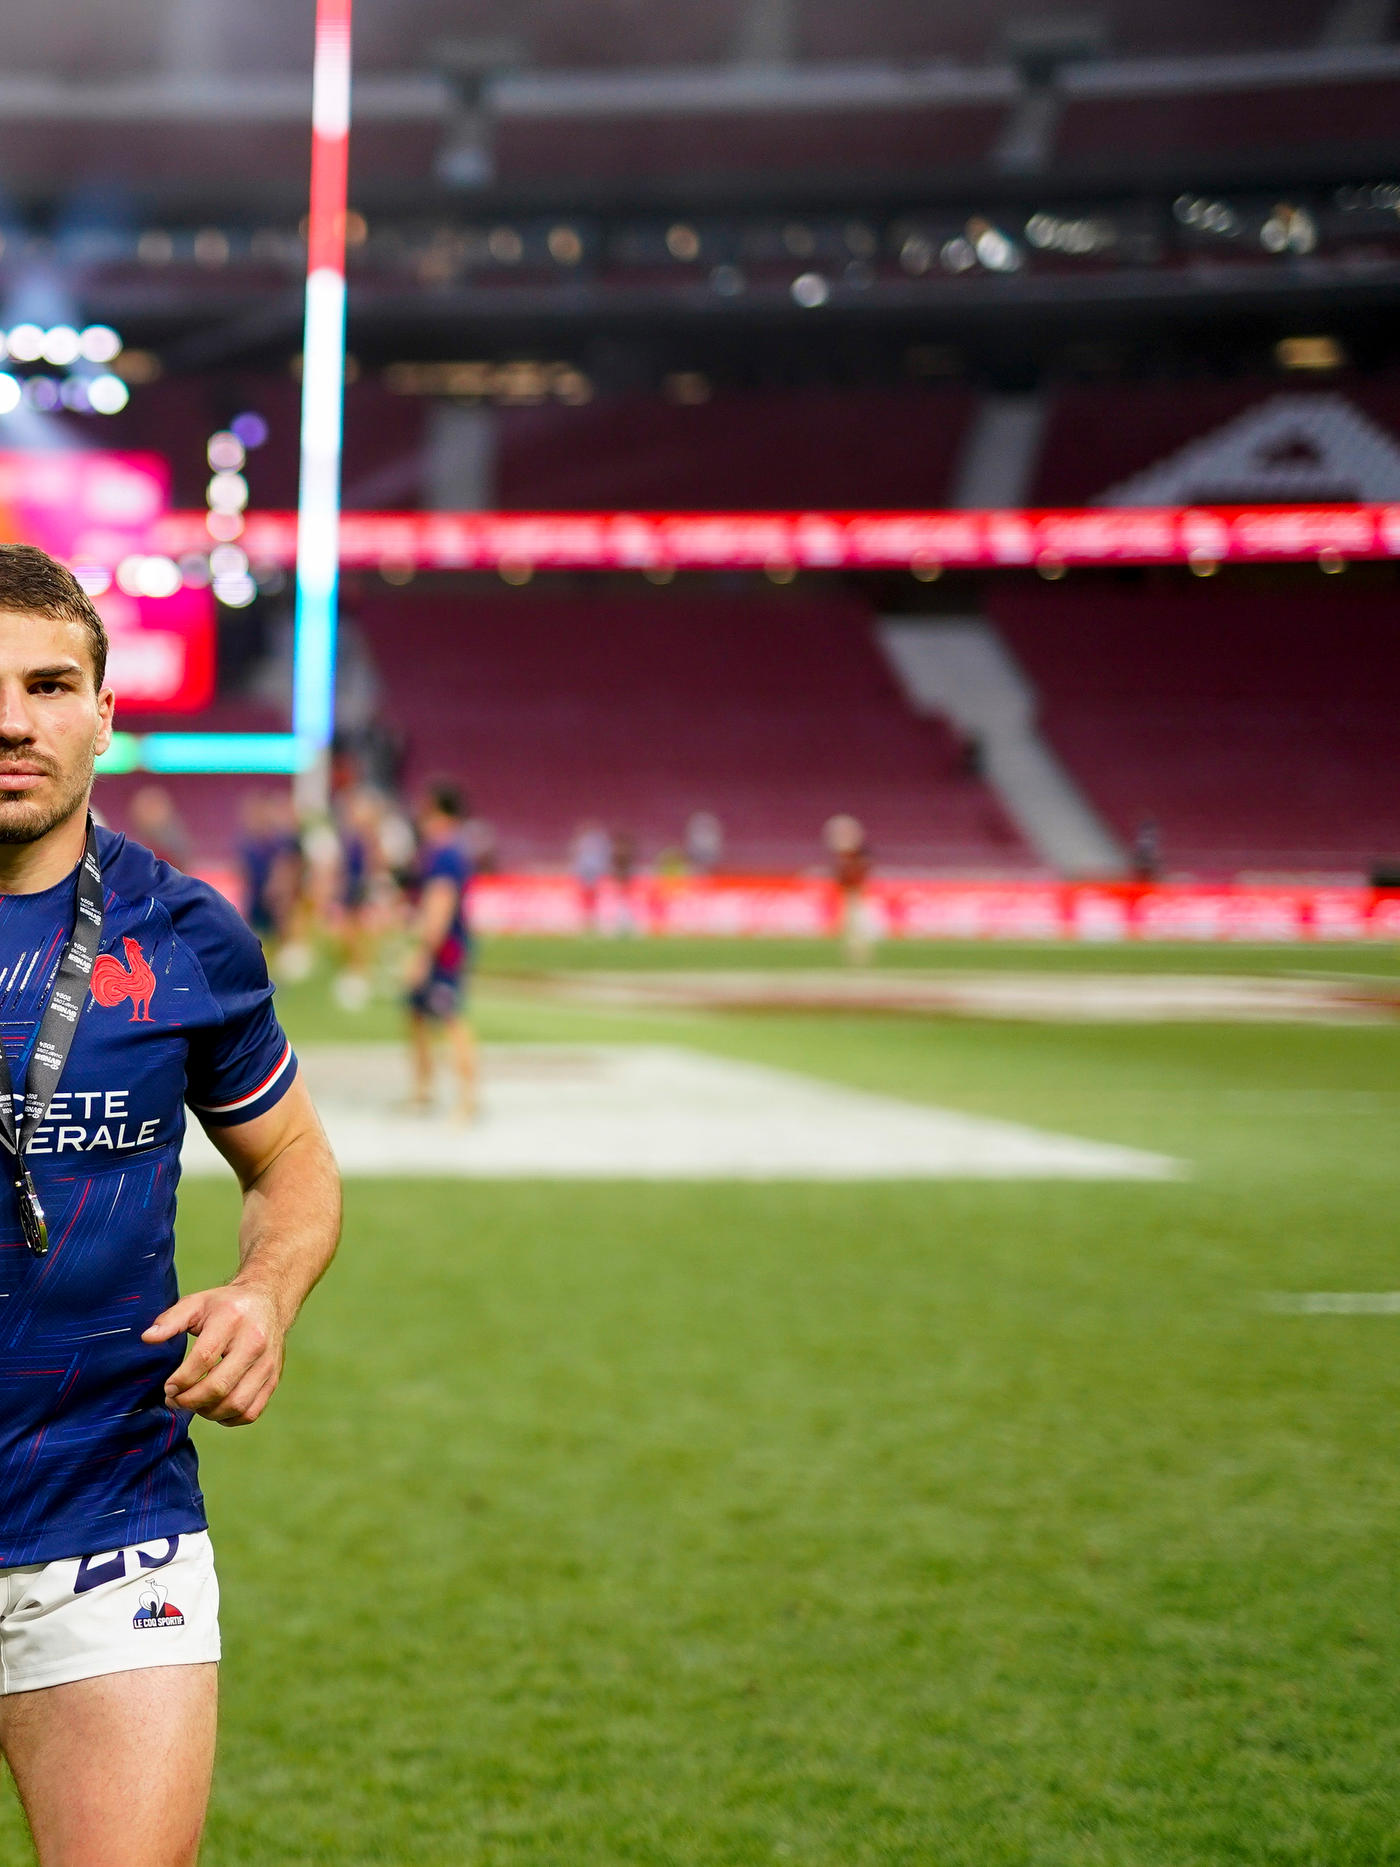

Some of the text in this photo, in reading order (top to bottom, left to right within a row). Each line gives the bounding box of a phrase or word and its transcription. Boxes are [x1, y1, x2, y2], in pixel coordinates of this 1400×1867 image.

[56, 992, 71, 1001] 2024
[39, 1041, 55, 1050] 2024
[134, 1616, 184, 1628] LE COQ SPORTIF
